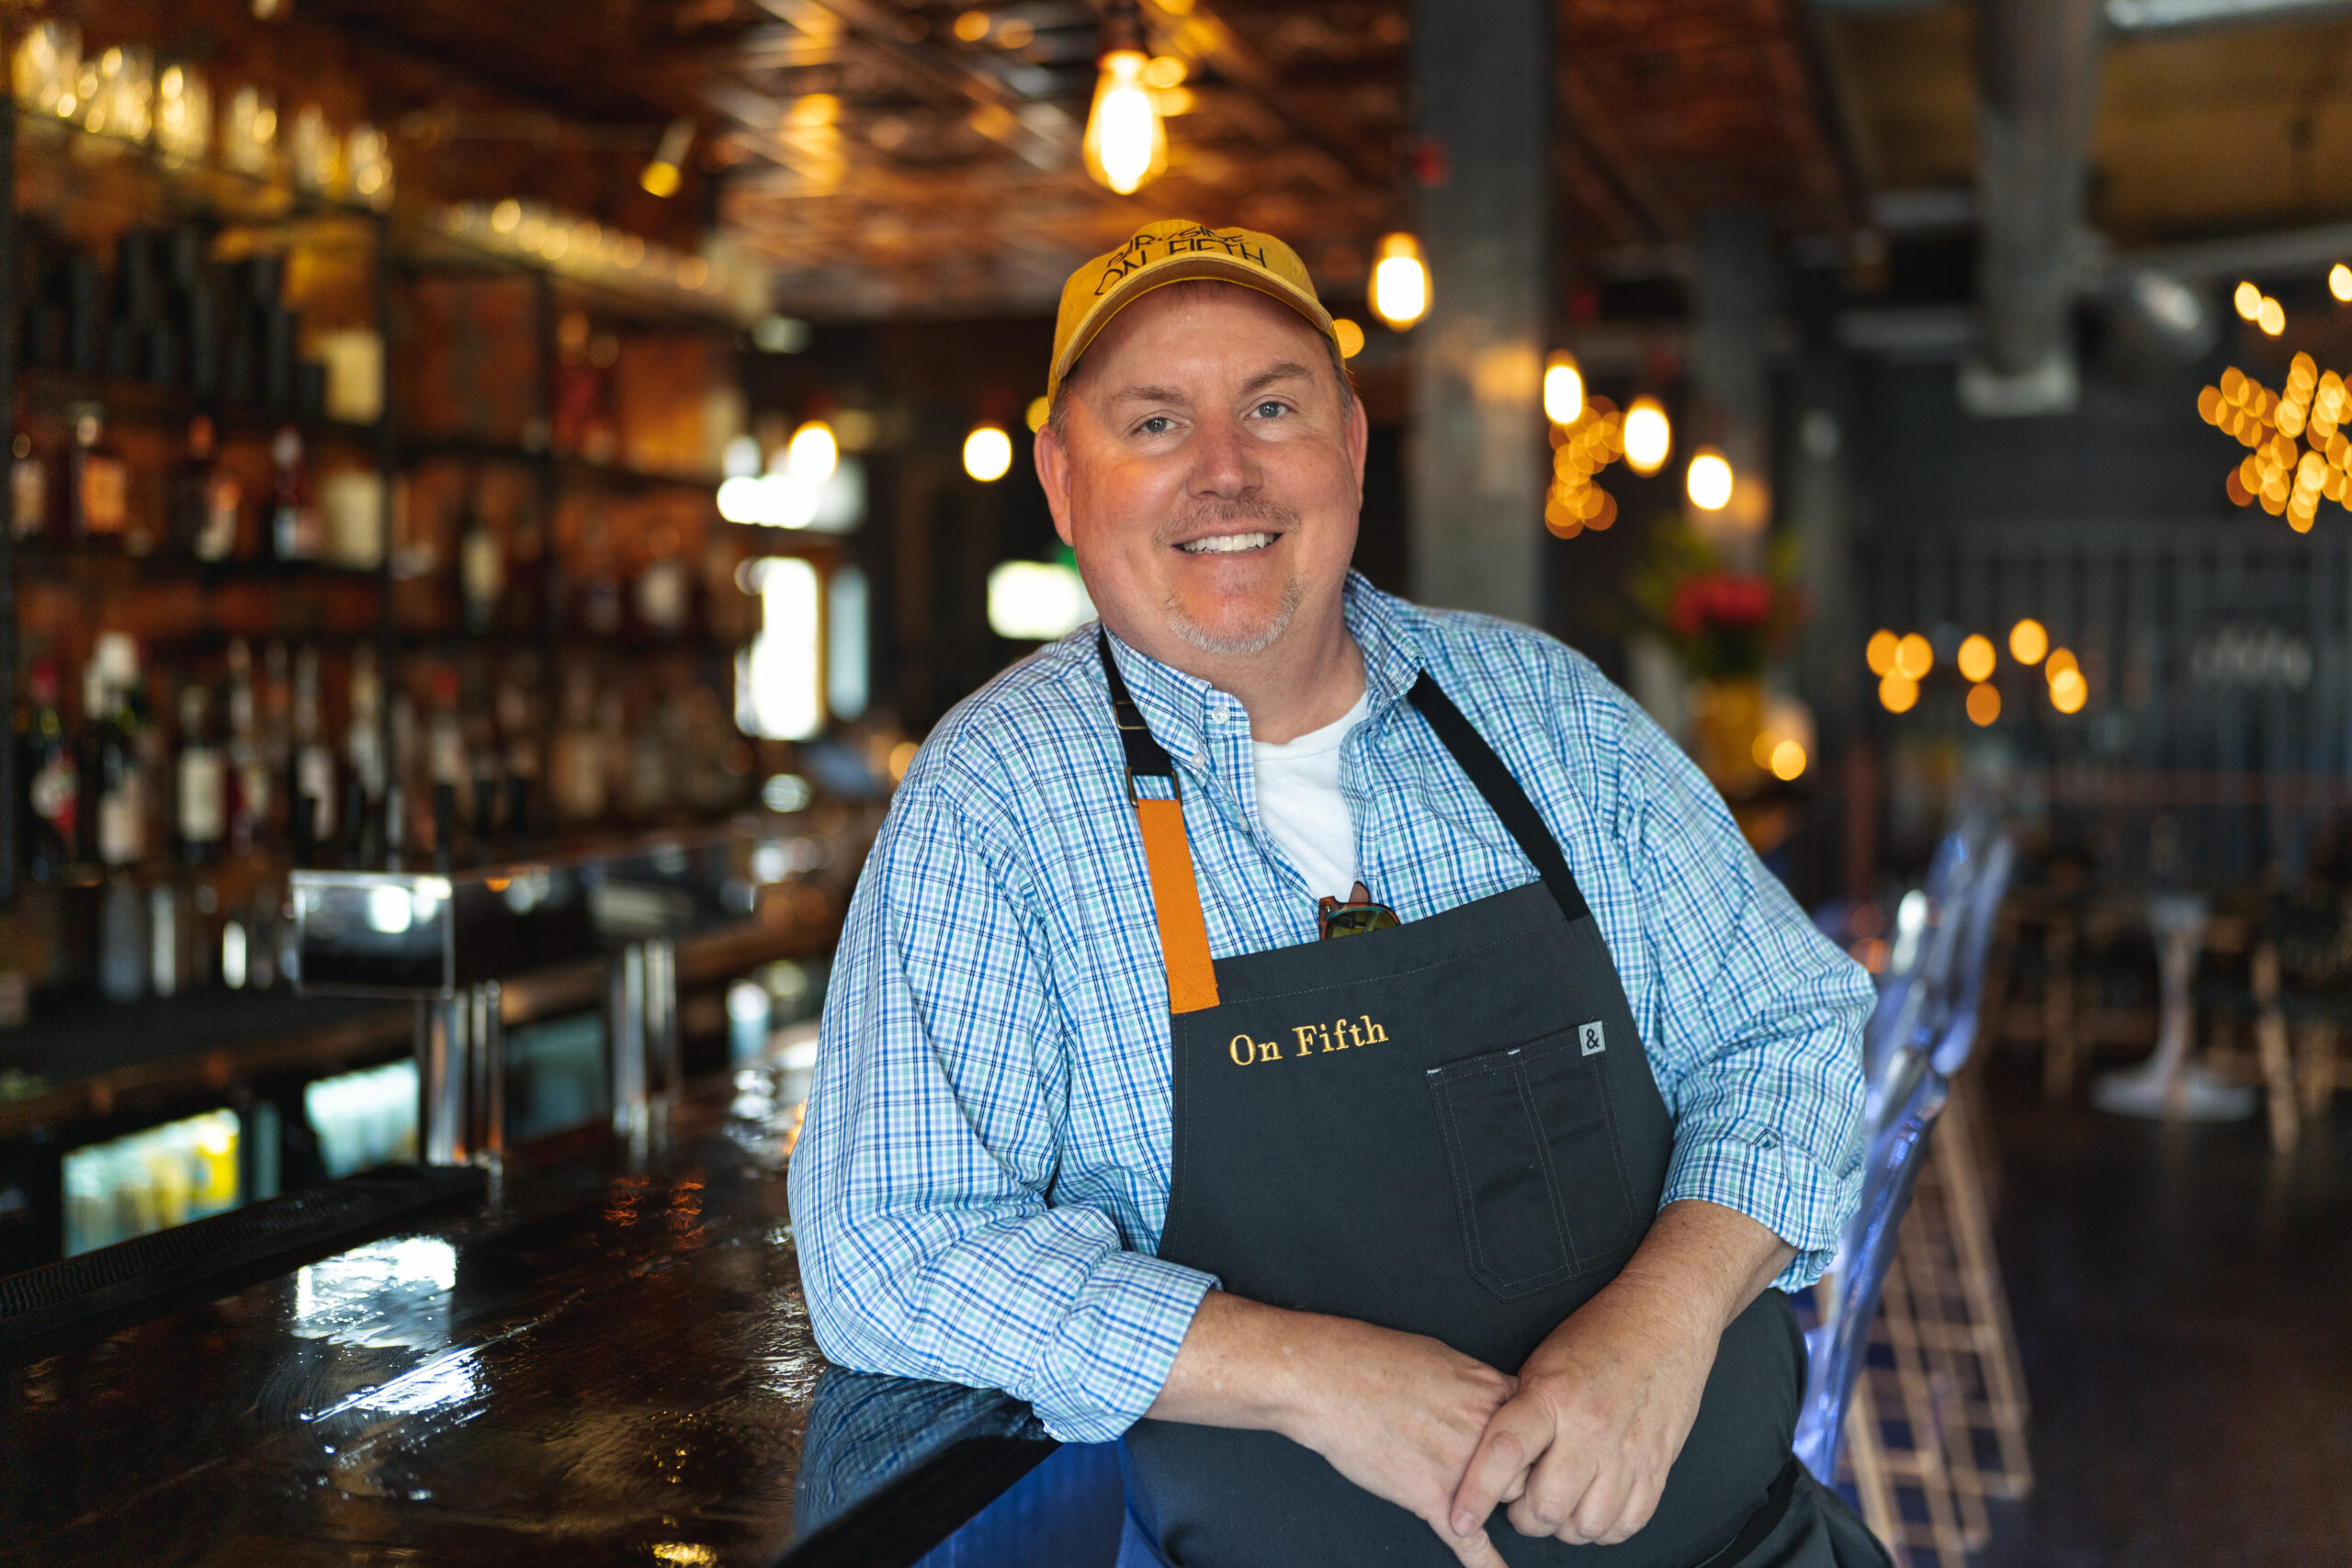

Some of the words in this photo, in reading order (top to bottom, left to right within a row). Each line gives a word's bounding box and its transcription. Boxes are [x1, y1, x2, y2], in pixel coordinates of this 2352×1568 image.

[1094, 249, 1147, 296] ON
[1169, 238, 1268, 269] FIFTH
[1228, 1034, 1283, 1066] On
[1291, 1014, 1388, 1056] Fifth
[1586, 1028, 1600, 1050] &
